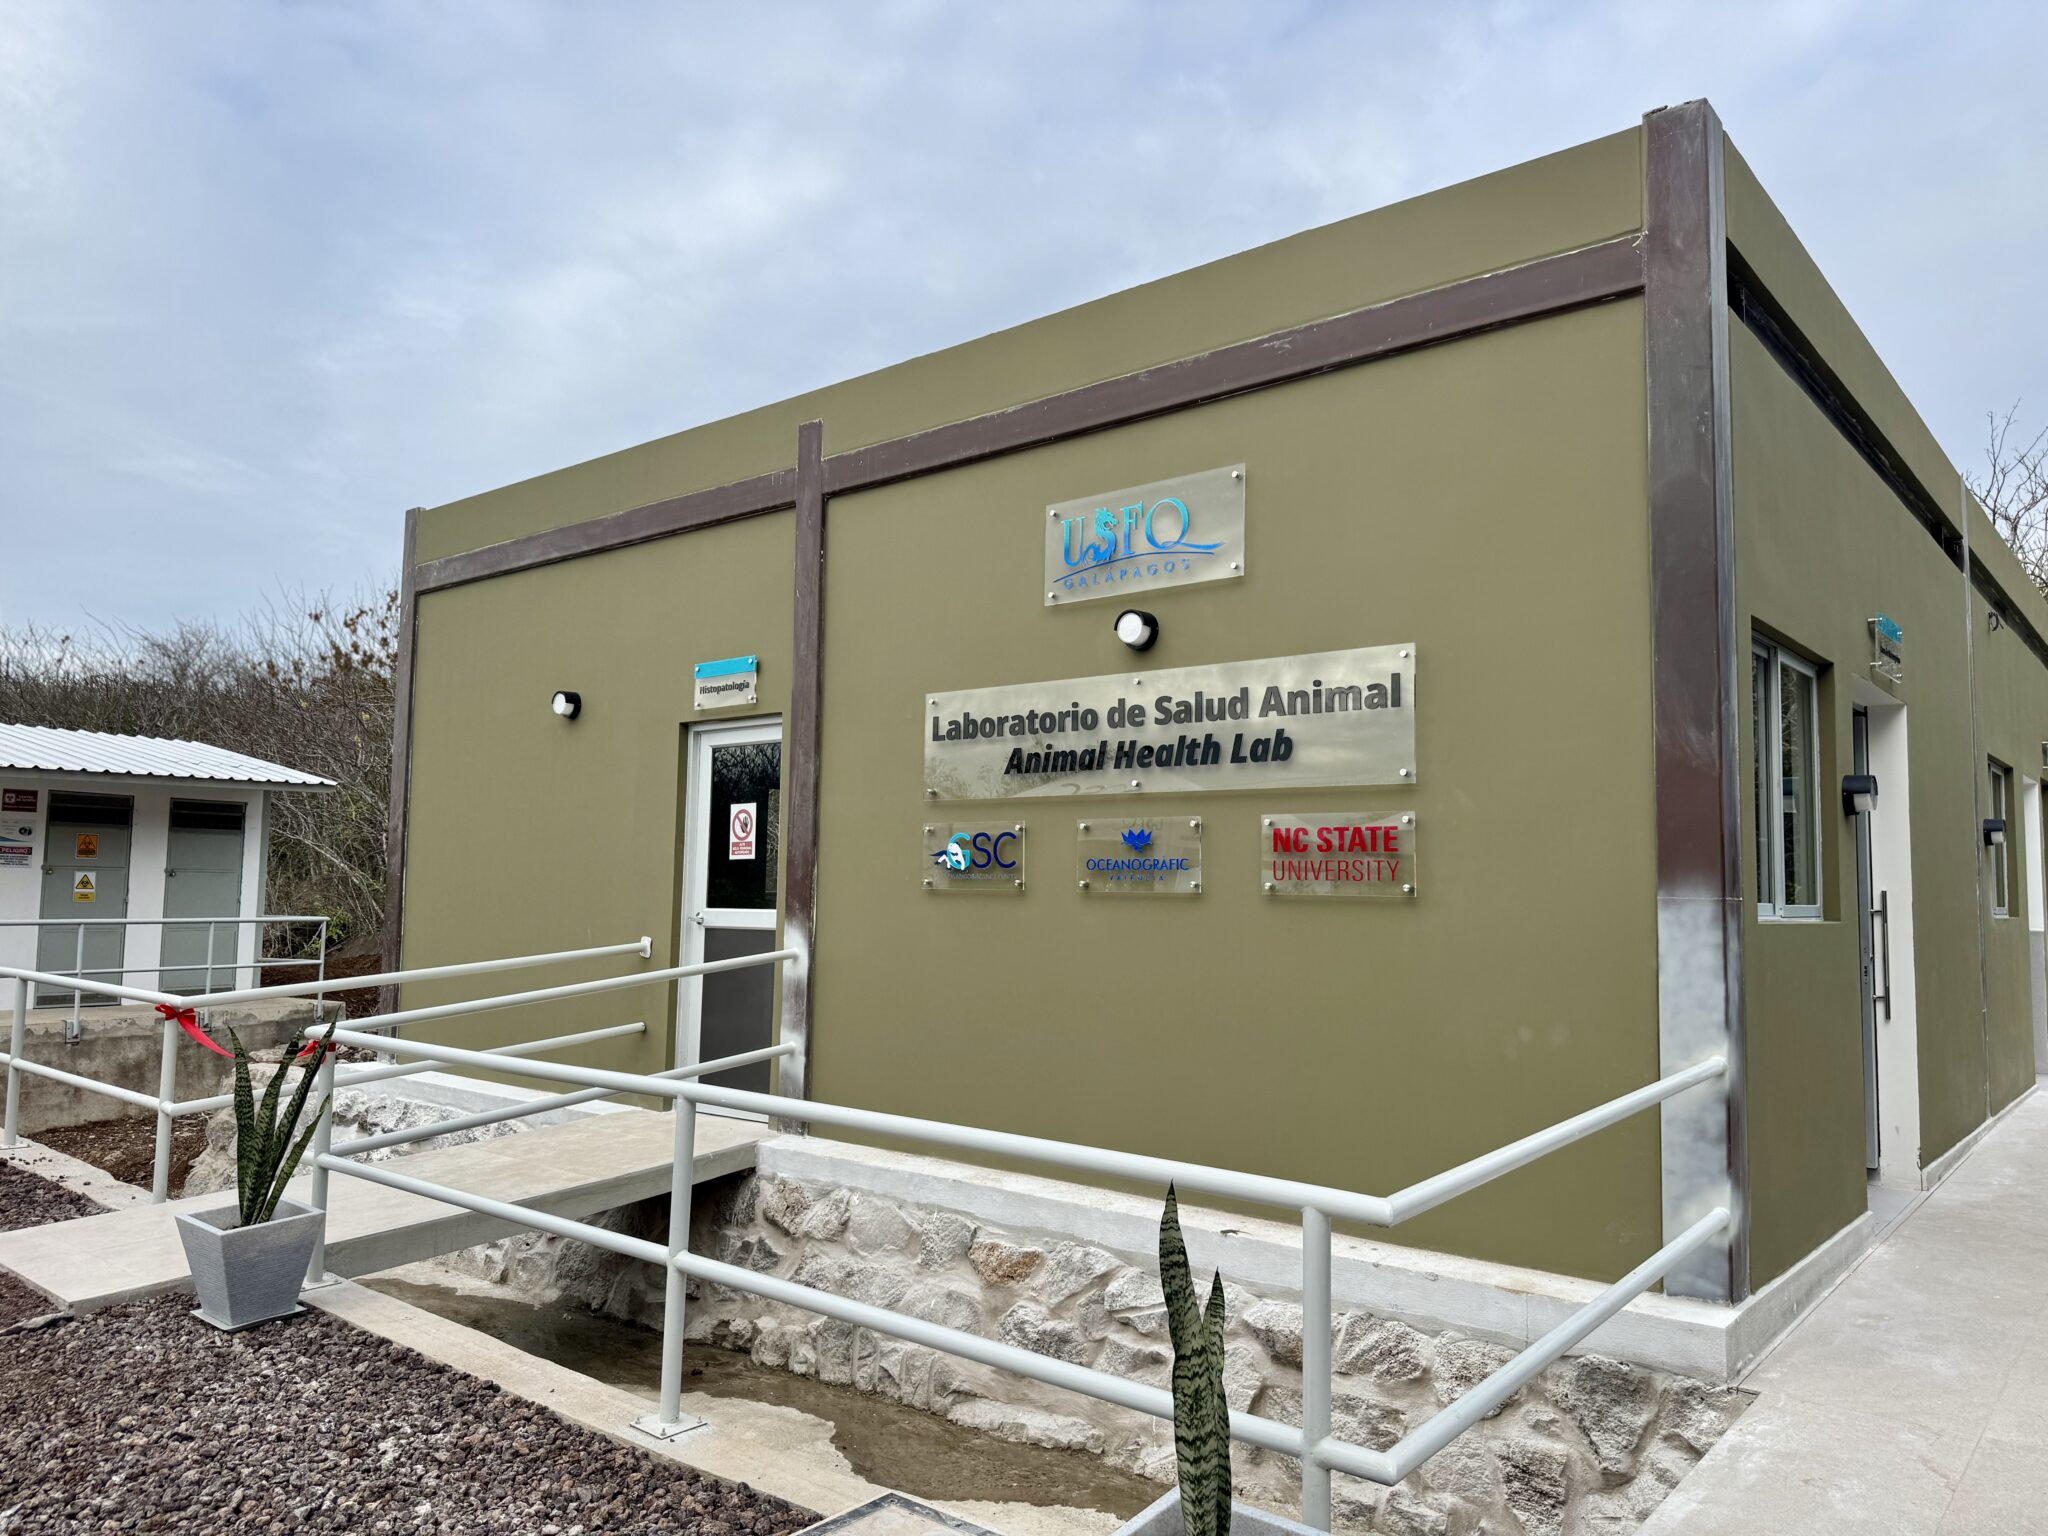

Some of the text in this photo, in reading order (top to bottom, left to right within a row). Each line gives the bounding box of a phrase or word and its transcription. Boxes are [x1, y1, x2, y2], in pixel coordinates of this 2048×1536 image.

[1061, 497, 1226, 567] USFQ
[699, 680, 750, 695] Histopatología
[932, 672, 1401, 742] Laboratorio de Salud Animal
[1004, 728, 1293, 775] Animal Health Lab
[947, 831, 1017, 870] GSC
[1272, 826, 1399, 853] NC STATE
[1272, 859, 1400, 882] UNIVERSITY
